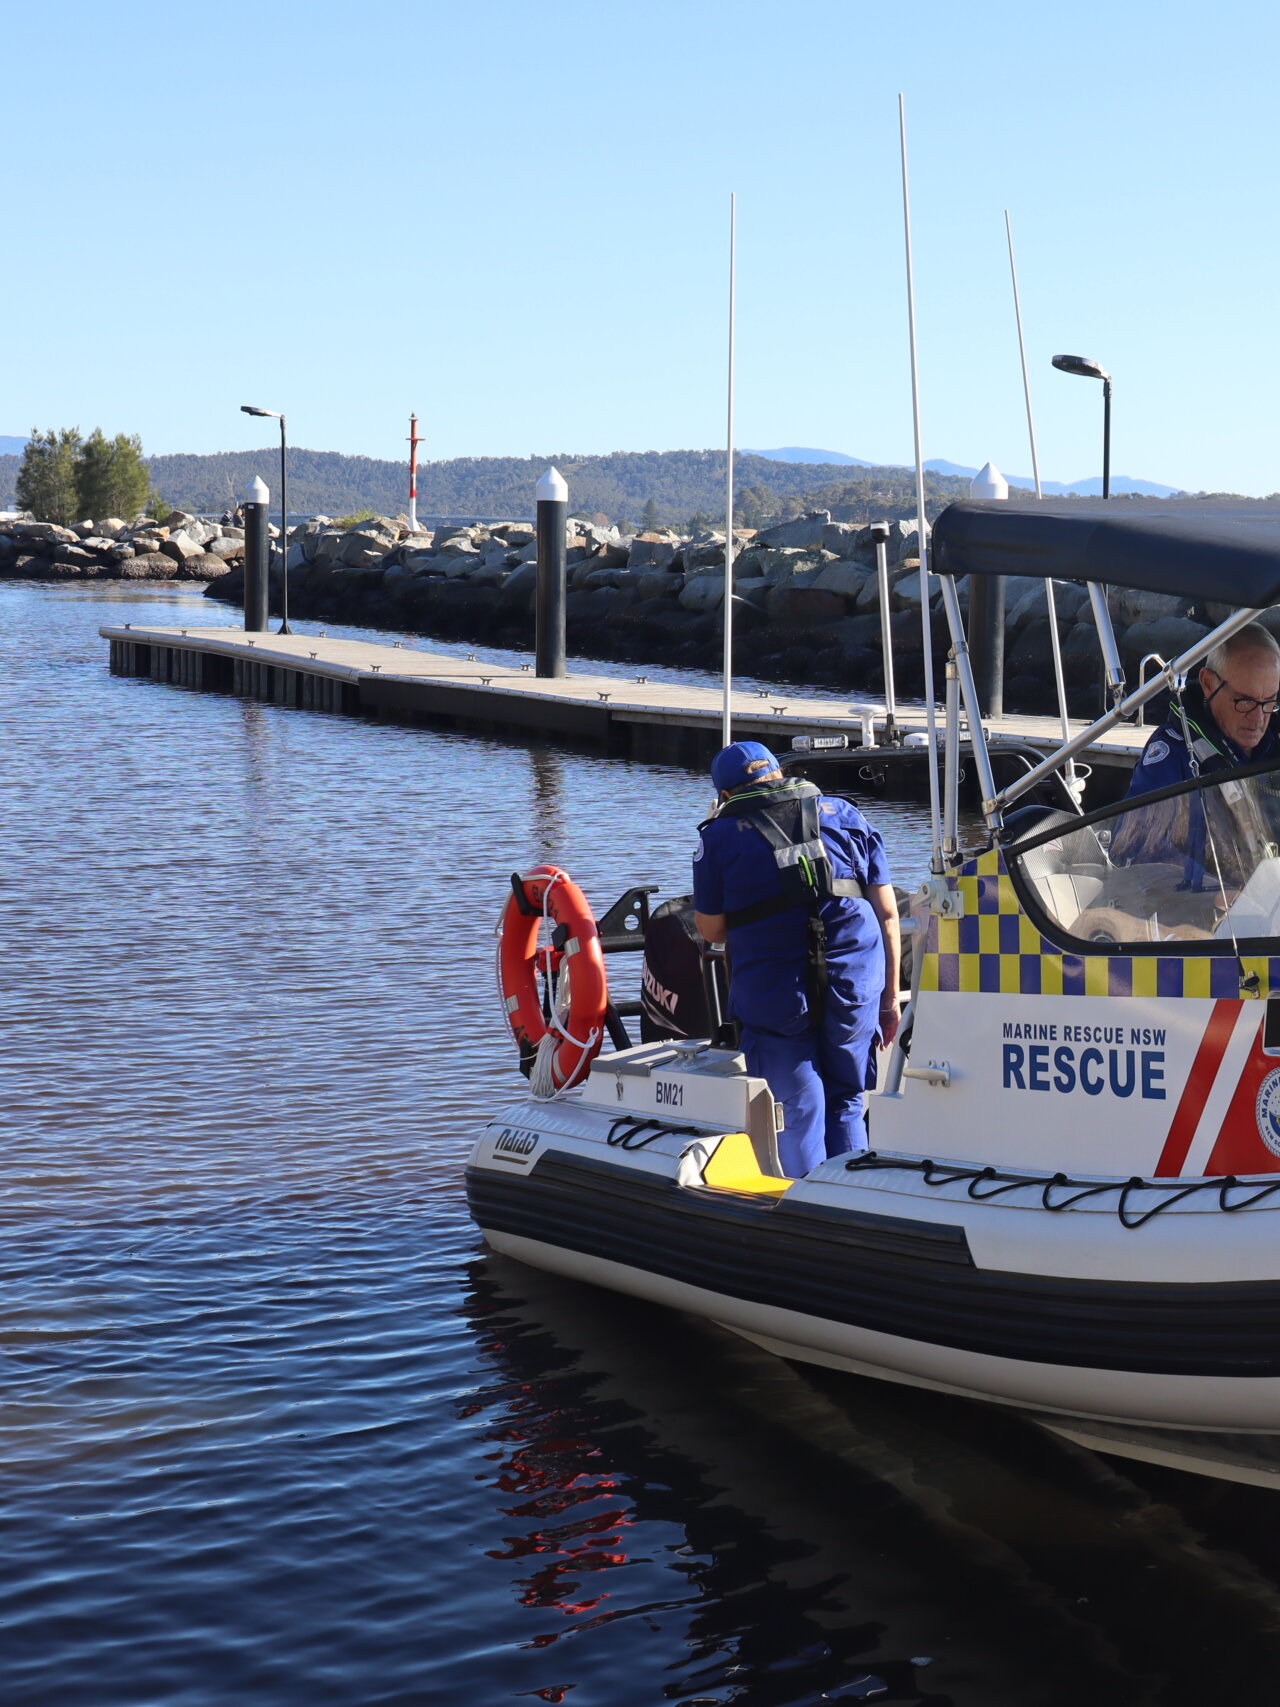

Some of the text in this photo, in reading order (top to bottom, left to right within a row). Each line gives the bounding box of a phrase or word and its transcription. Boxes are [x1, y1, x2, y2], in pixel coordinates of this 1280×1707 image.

[1002, 1022, 1167, 1046] MARINE RESCUE NSW
[1002, 1043, 1167, 1100] RESCUE
[656, 1081, 683, 1106] BM21
